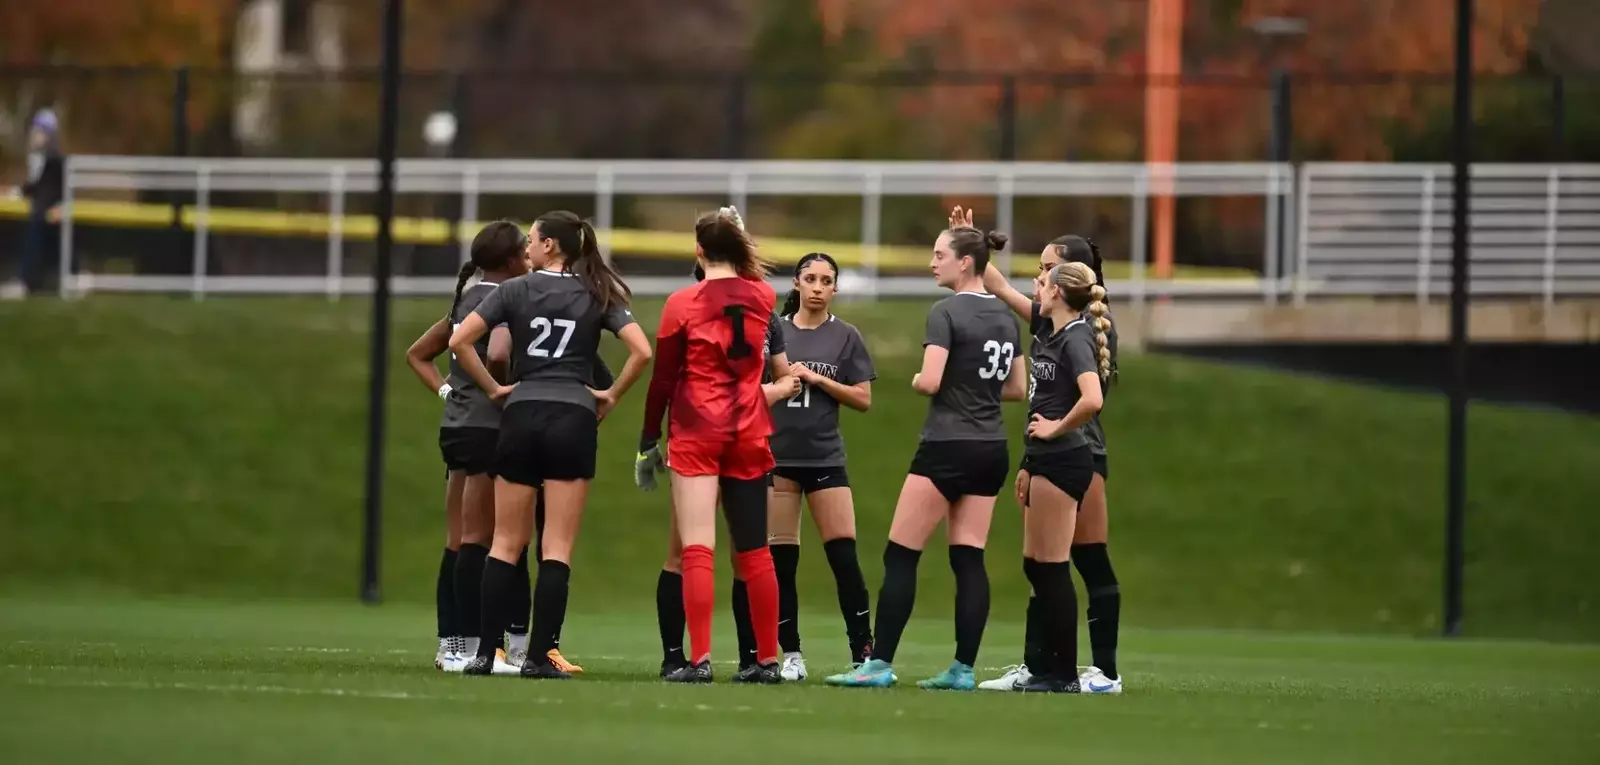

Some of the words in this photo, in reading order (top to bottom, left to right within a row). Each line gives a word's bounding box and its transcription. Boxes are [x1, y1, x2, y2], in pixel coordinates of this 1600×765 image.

[527, 316, 576, 358] 27
[723, 304, 752, 359] 1
[979, 340, 1014, 381] 33
